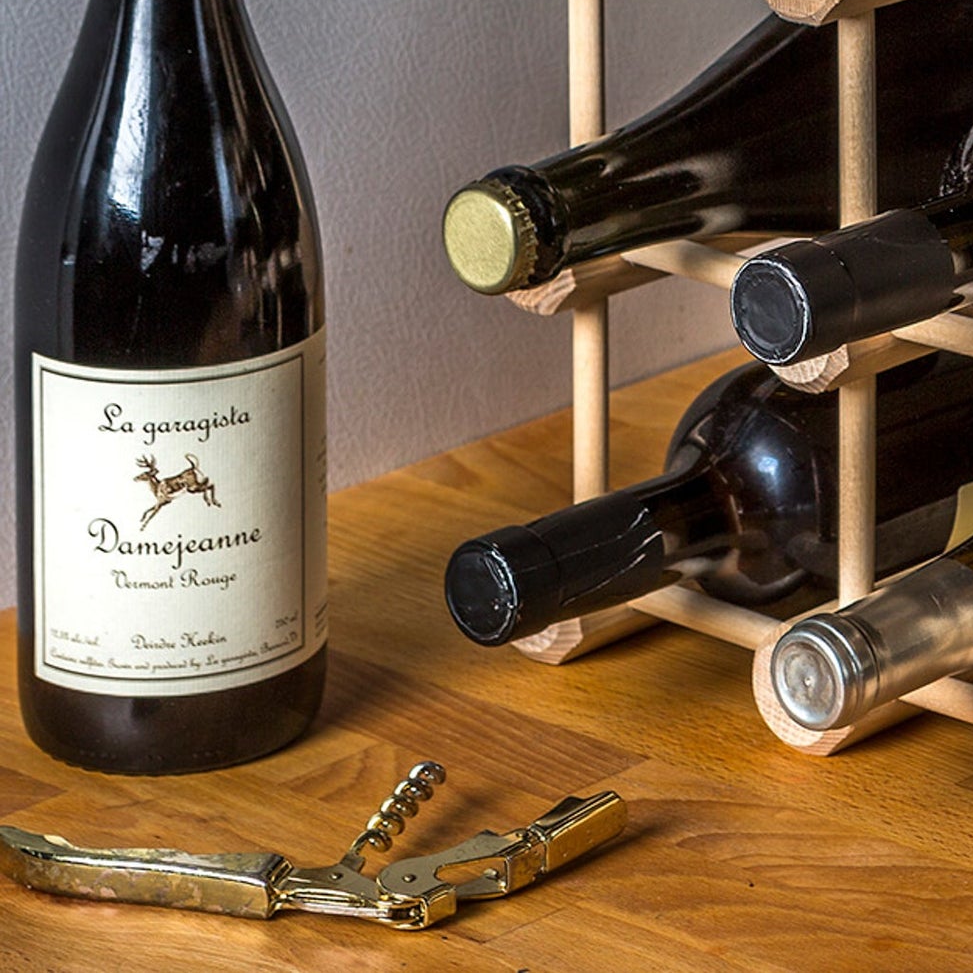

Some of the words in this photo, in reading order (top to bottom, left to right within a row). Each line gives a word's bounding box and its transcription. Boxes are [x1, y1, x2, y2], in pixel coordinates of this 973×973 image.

[98, 403, 133, 433] La
[143, 406, 252, 446] garagista
[88, 518, 262, 570] Damejeanne
[111, 569, 174, 589] Vermont
[180, 568, 237, 591] Rouge
